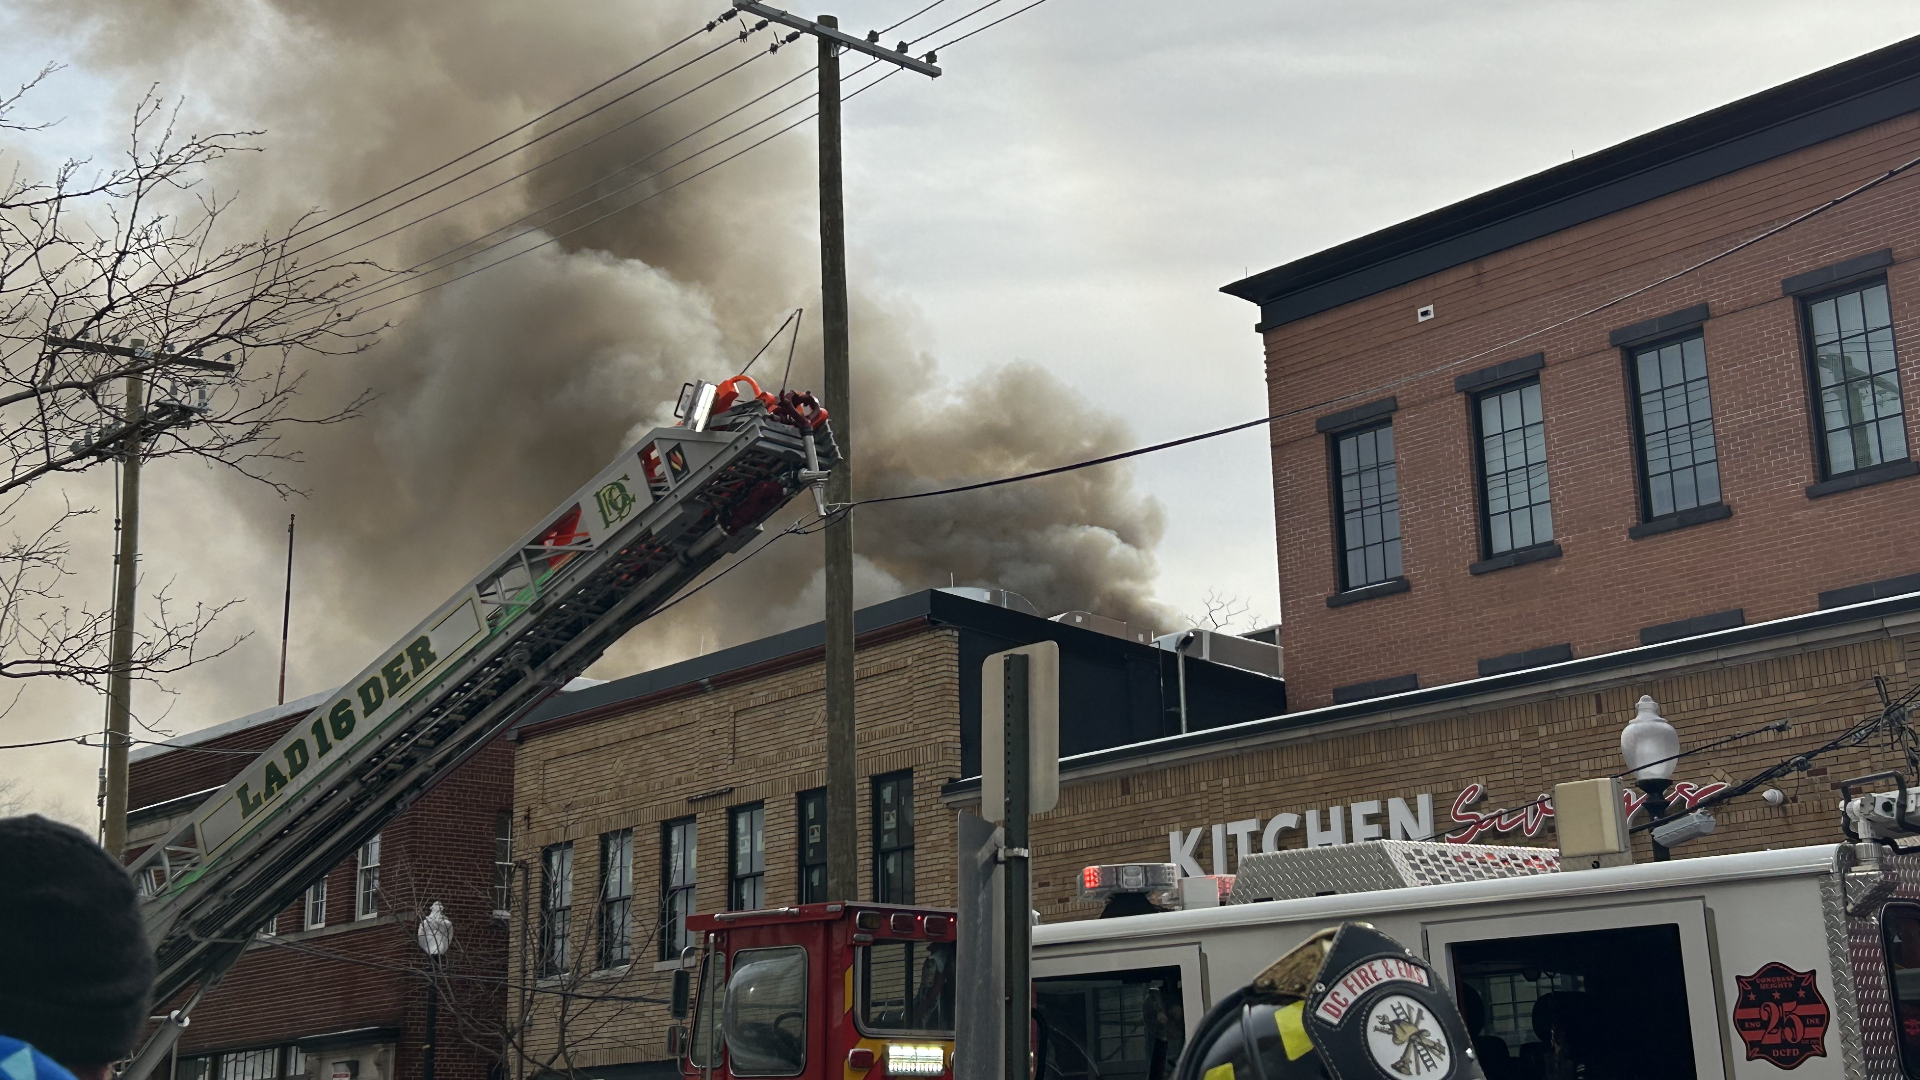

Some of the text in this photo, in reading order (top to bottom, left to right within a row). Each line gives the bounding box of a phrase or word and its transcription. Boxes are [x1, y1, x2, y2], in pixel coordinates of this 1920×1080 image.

[311, 698, 356, 759] 16
[357, 635, 437, 719] DER
[1169, 793, 1435, 877] KITCHEN
[1322, 959, 1425, 1019] DC FIRE & EMS
[1760, 1001, 1805, 1043] 25
[1772, 1048, 1800, 1057] DCFD
